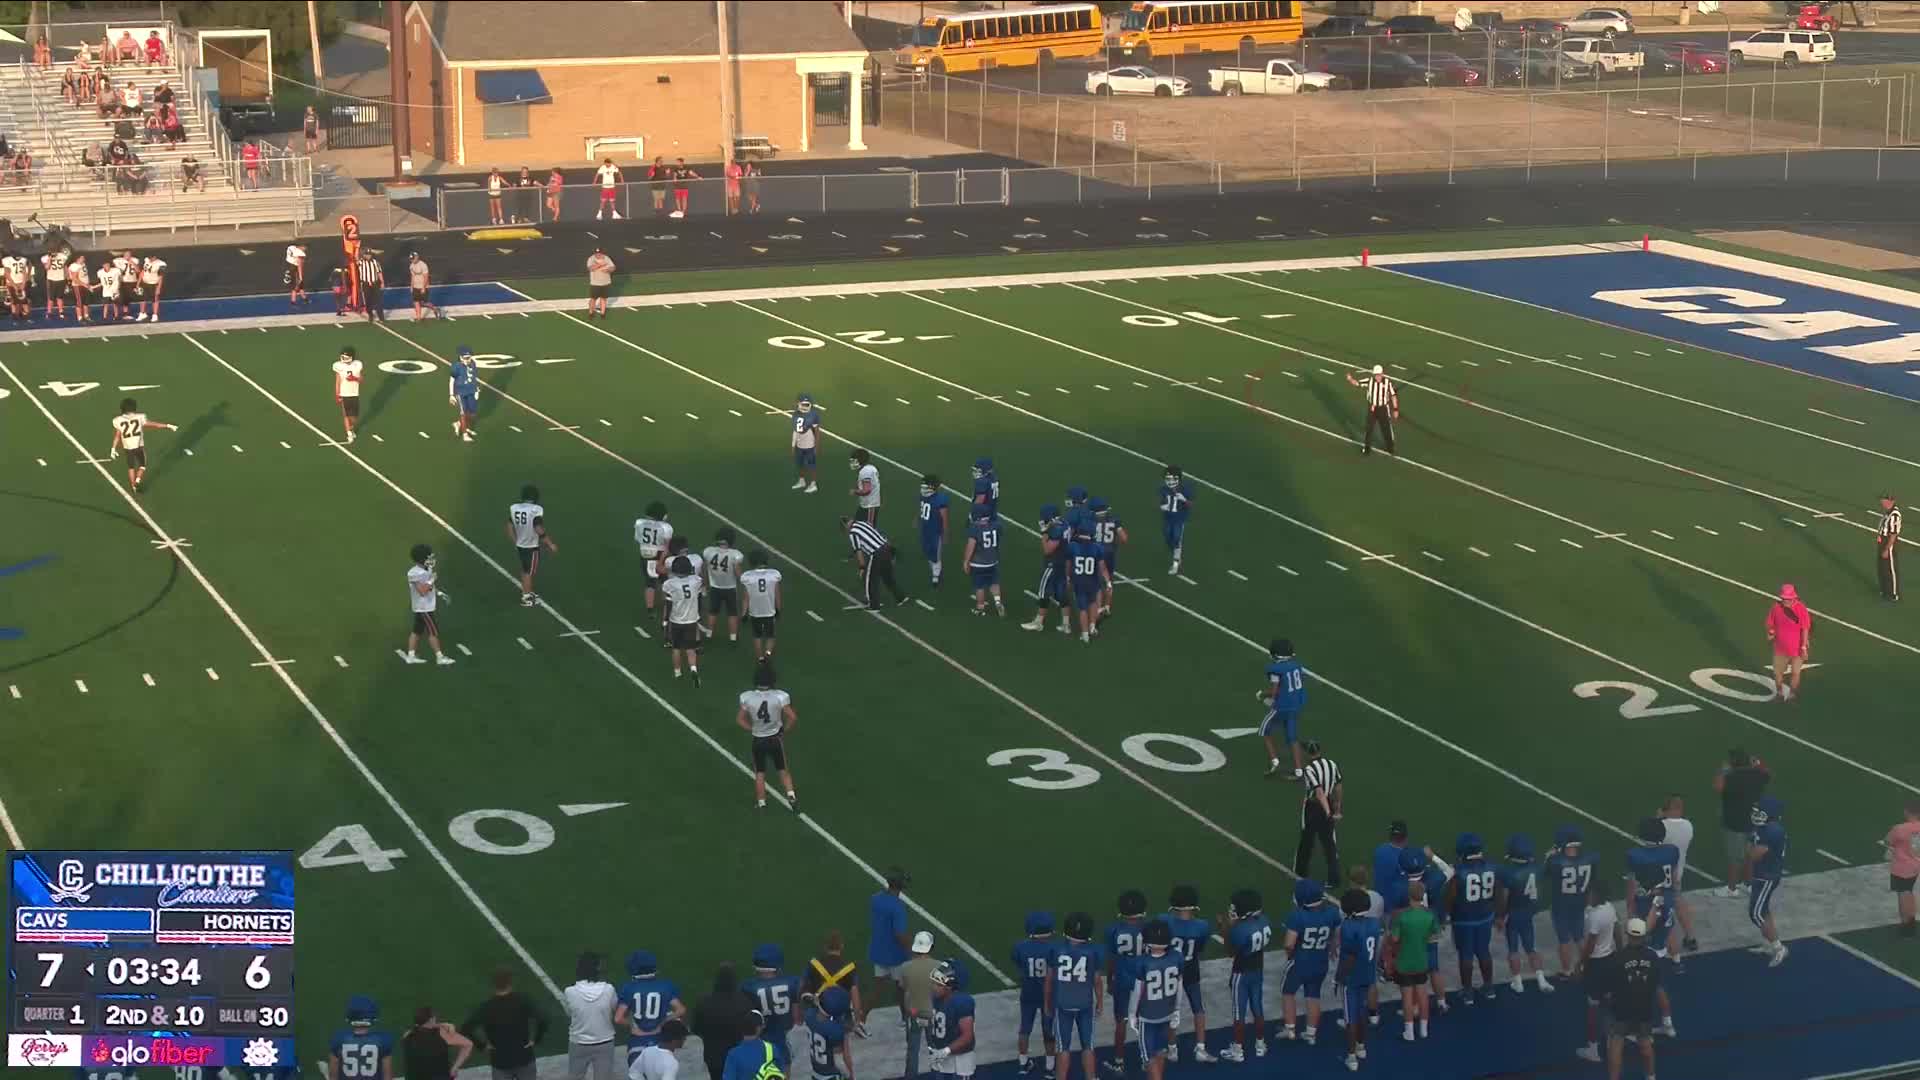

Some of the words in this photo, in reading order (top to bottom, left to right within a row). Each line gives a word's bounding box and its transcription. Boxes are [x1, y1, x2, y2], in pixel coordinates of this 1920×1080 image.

[120, 419, 141, 439] 22
[796, 417, 804, 432] 2
[642, 528, 658, 546] 51
[983, 530, 998, 548] 51
[710, 554, 729, 572] 44
[1075, 556, 1095, 575] 50
[682, 585, 692, 599] 5
[758, 578, 767, 592] 8
[1286, 670, 1302, 692] 18
[757, 700, 771, 724] 4
[986, 732, 1227, 790] 30
[299, 808, 556, 874] 40
[1466, 871, 1496, 902] 69
[1561, 865, 1592, 893] 27
[1302, 926, 1330, 950] 52
[1028, 957, 1048, 978] 19
[1057, 955, 1087, 983] 24
[1146, 966, 1179, 1001] 26
[632, 991, 662, 1020] 10
[756, 984, 790, 1016] 15
[342, 1043, 379, 1077] 53
